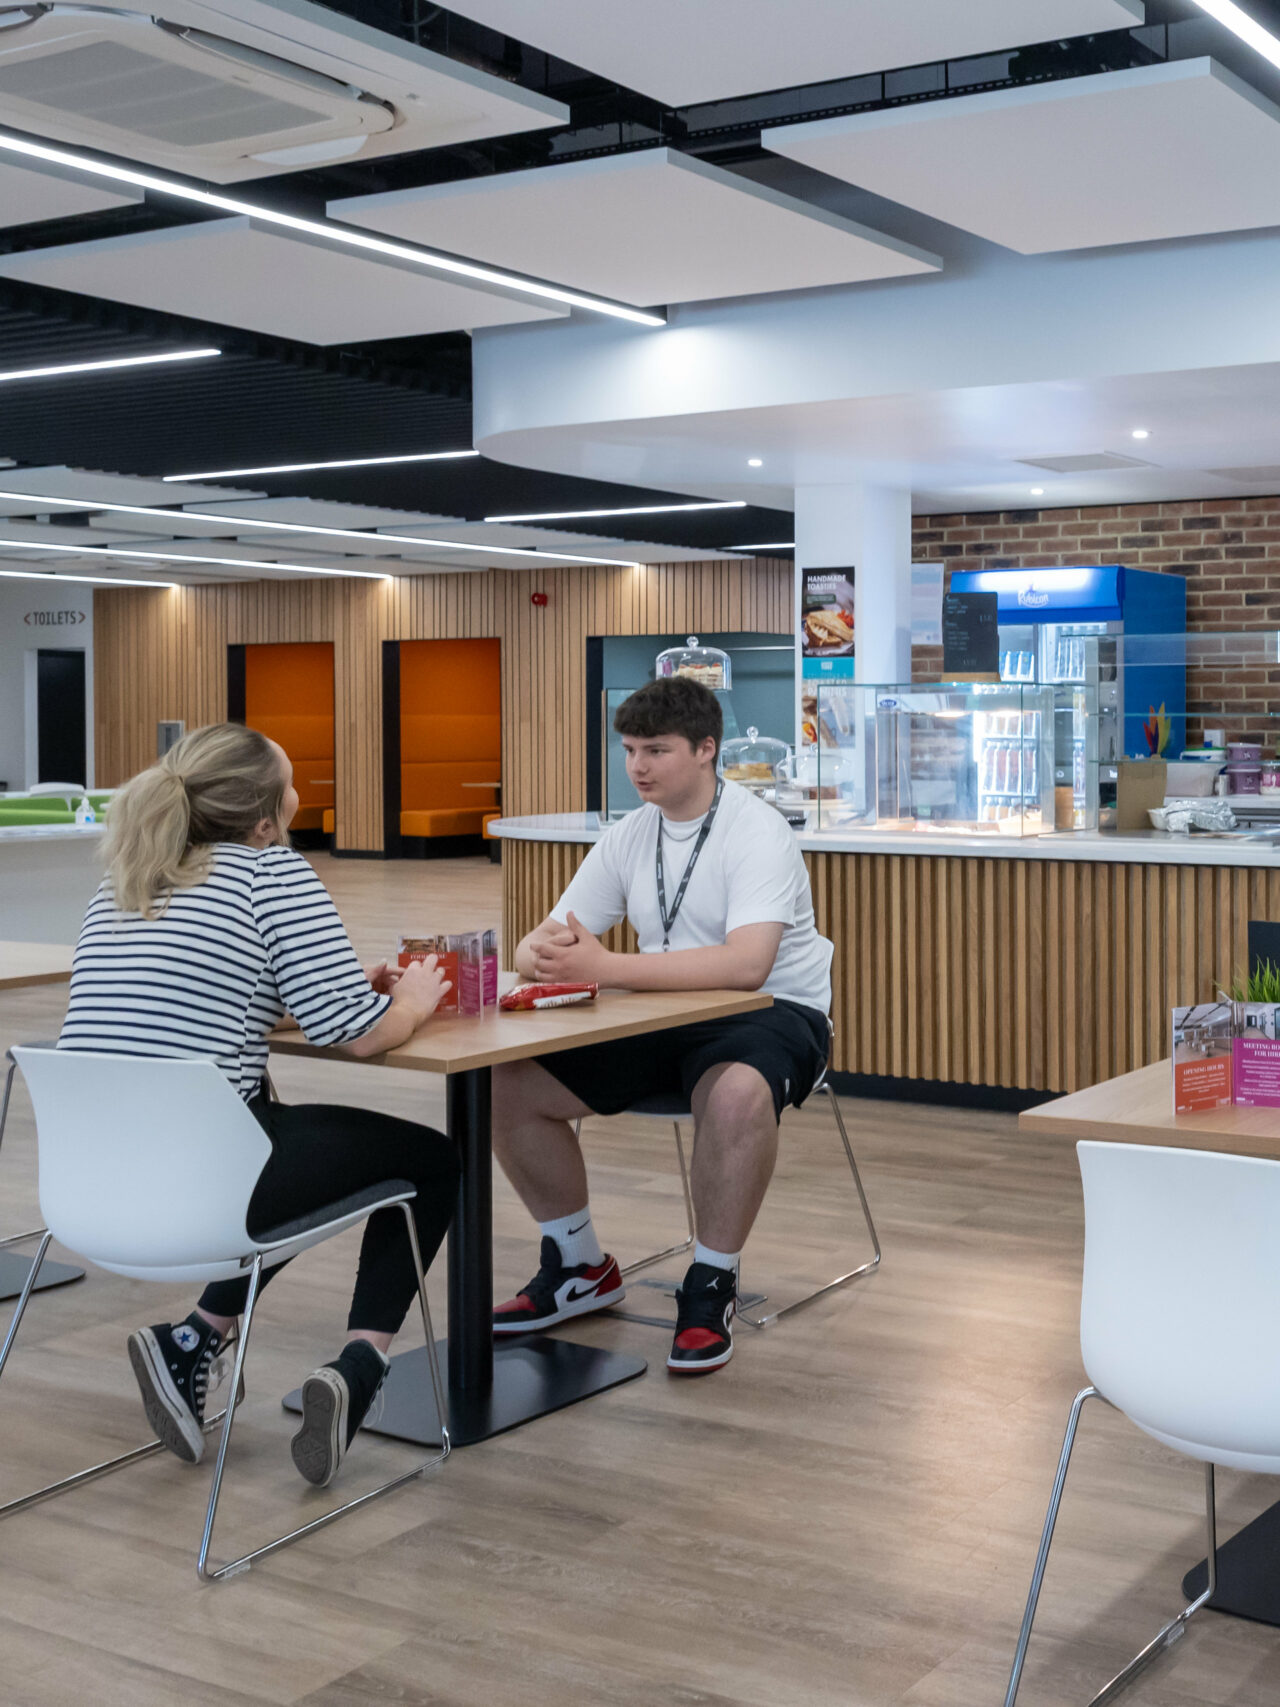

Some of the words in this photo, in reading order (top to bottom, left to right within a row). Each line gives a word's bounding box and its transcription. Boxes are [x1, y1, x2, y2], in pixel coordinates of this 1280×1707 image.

[807, 574, 846, 582] HANDMADE
[807, 583, 837, 591] TOASTIES
[1017, 590, 1049, 607] Rubicon
[33, 611, 76, 626] TOILETS
